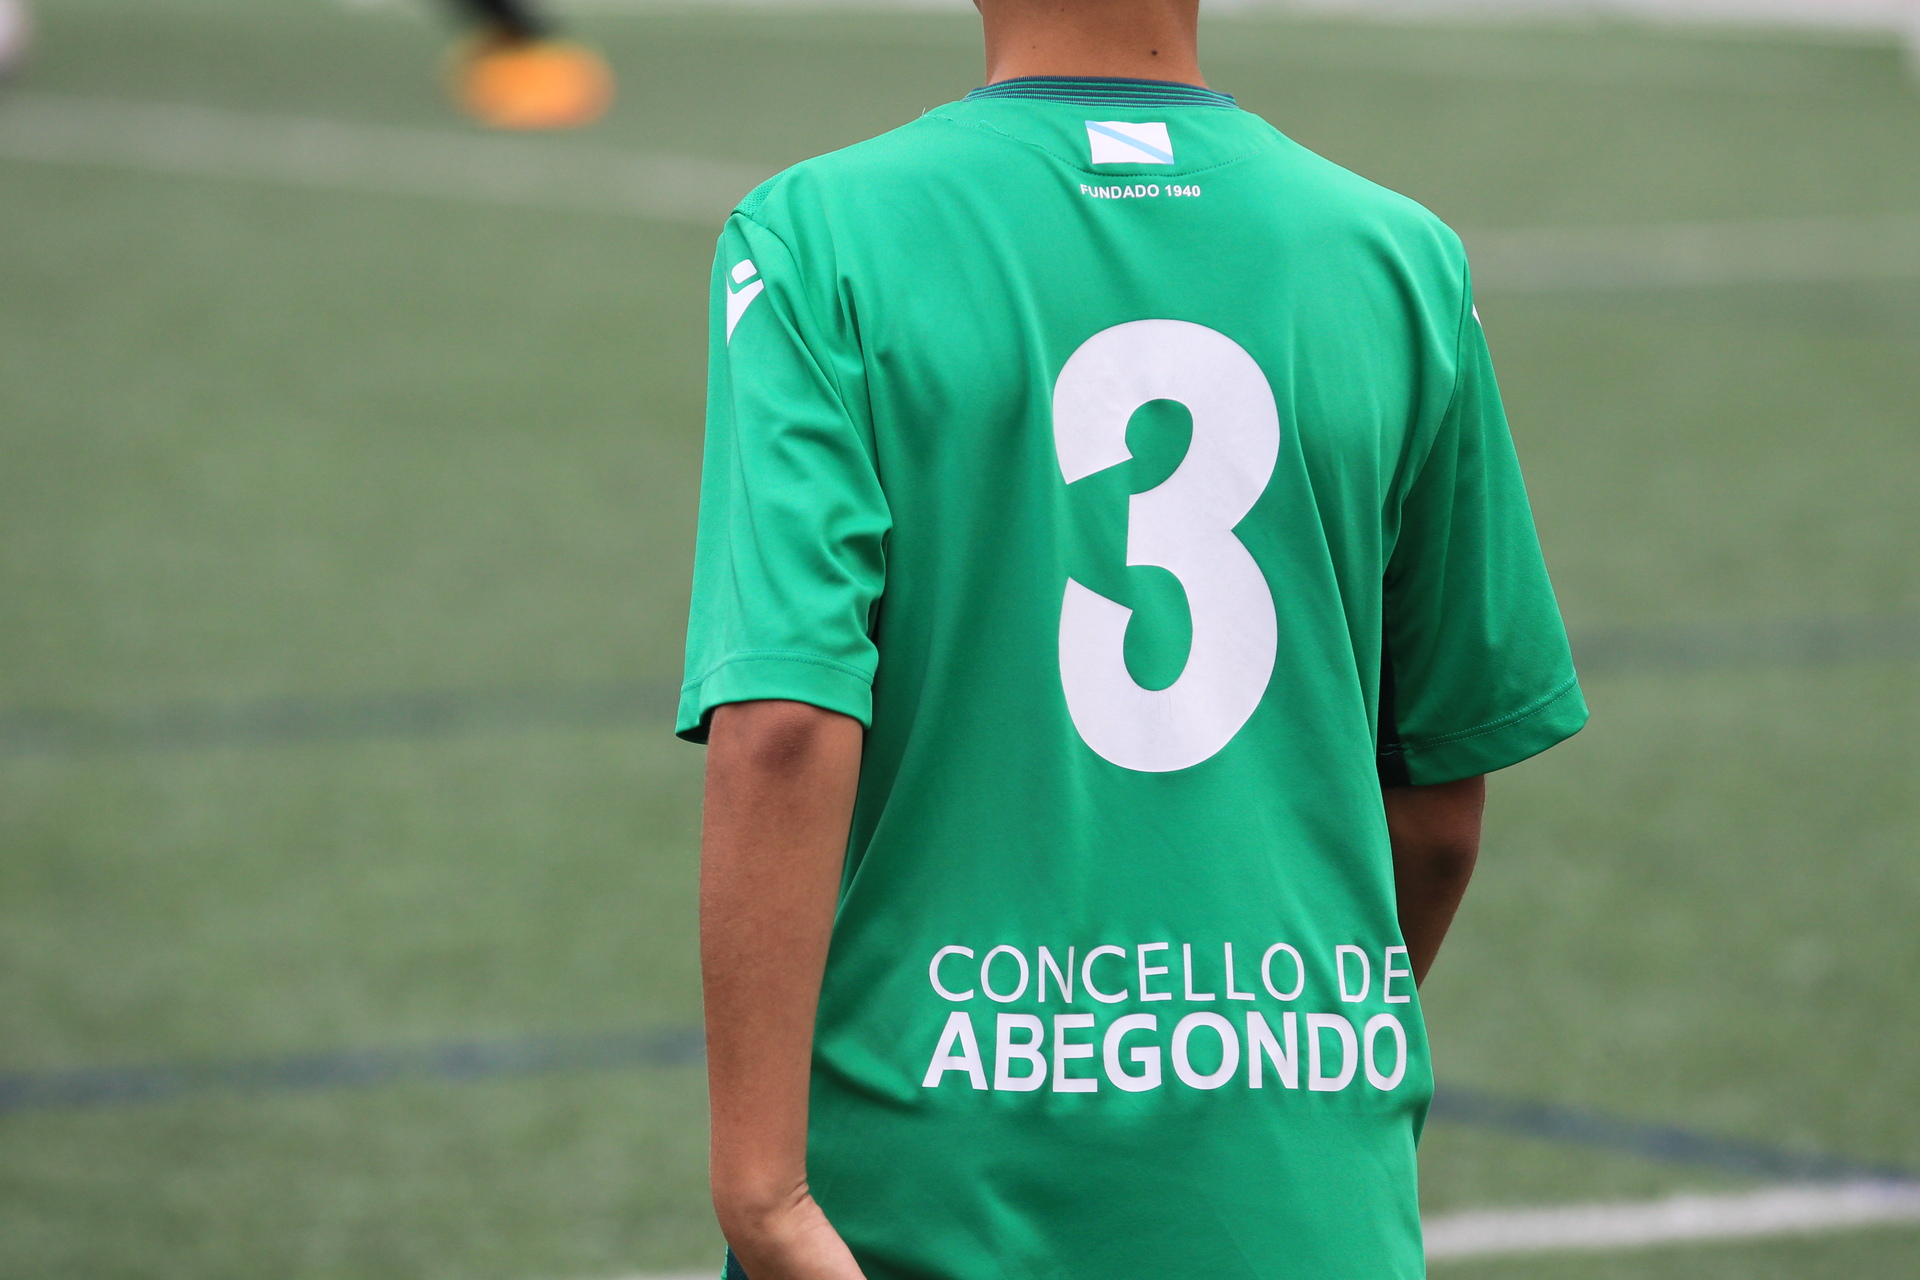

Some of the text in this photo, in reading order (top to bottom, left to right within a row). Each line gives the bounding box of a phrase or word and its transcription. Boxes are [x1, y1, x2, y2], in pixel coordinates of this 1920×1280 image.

[1079, 183, 1202, 200] FUNDADO 1940
[1053, 319, 1280, 773] 3
[928, 941, 1412, 1004] CONCELLO DE
[921, 1010, 1408, 1093] ABEGONDO
